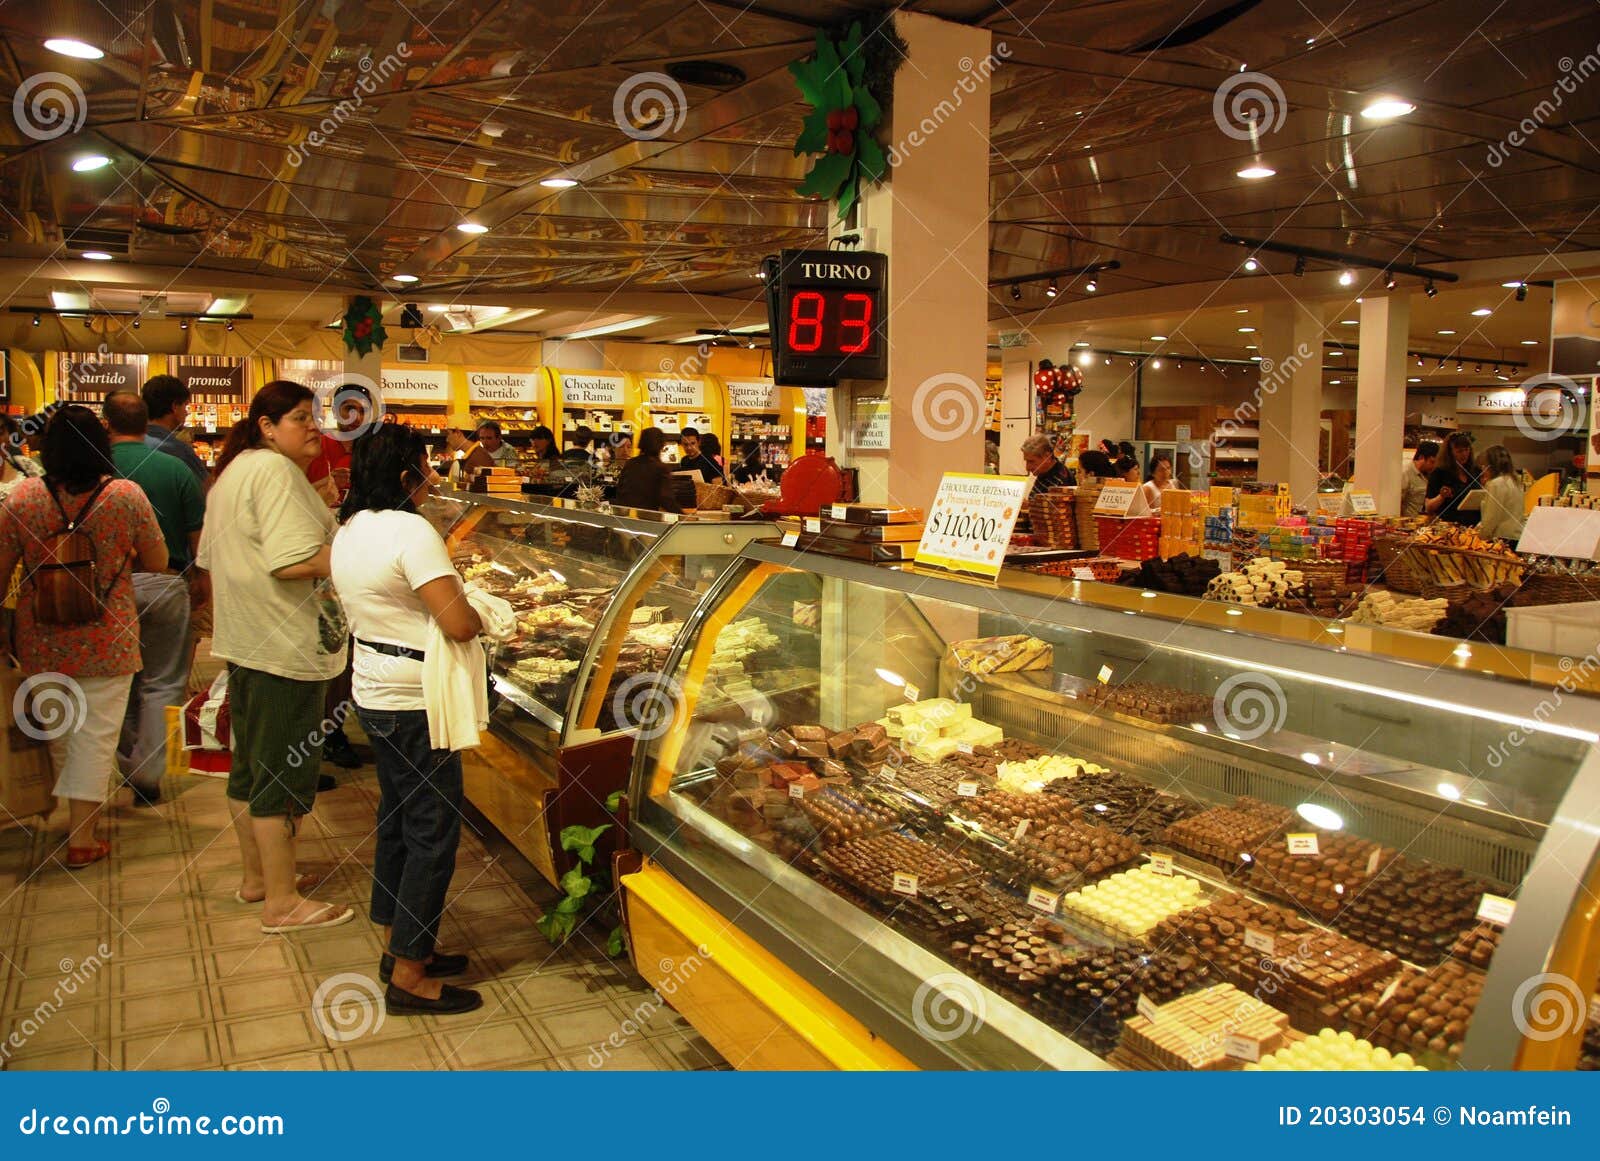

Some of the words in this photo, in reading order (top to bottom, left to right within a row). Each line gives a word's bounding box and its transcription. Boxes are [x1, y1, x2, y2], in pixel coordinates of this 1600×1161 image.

[801, 263, 871, 280] TURNO
[788, 291, 872, 353] 83
[80, 372, 126, 385] surtido
[188, 375, 232, 388] promos
[381, 378, 439, 390] Bombones
[471, 374, 526, 387] Chocolate
[564, 377, 616, 390] Chocolate
[478, 387, 520, 399] Surtido
[647, 381, 696, 394] Chocolate
[728, 384, 760, 396] Figuras
[761, 386, 773, 396] de
[566, 392, 580, 401] en
[583, 389, 613, 402] Rama
[650, 394, 663, 404] en
[665, 392, 693, 405] Rama
